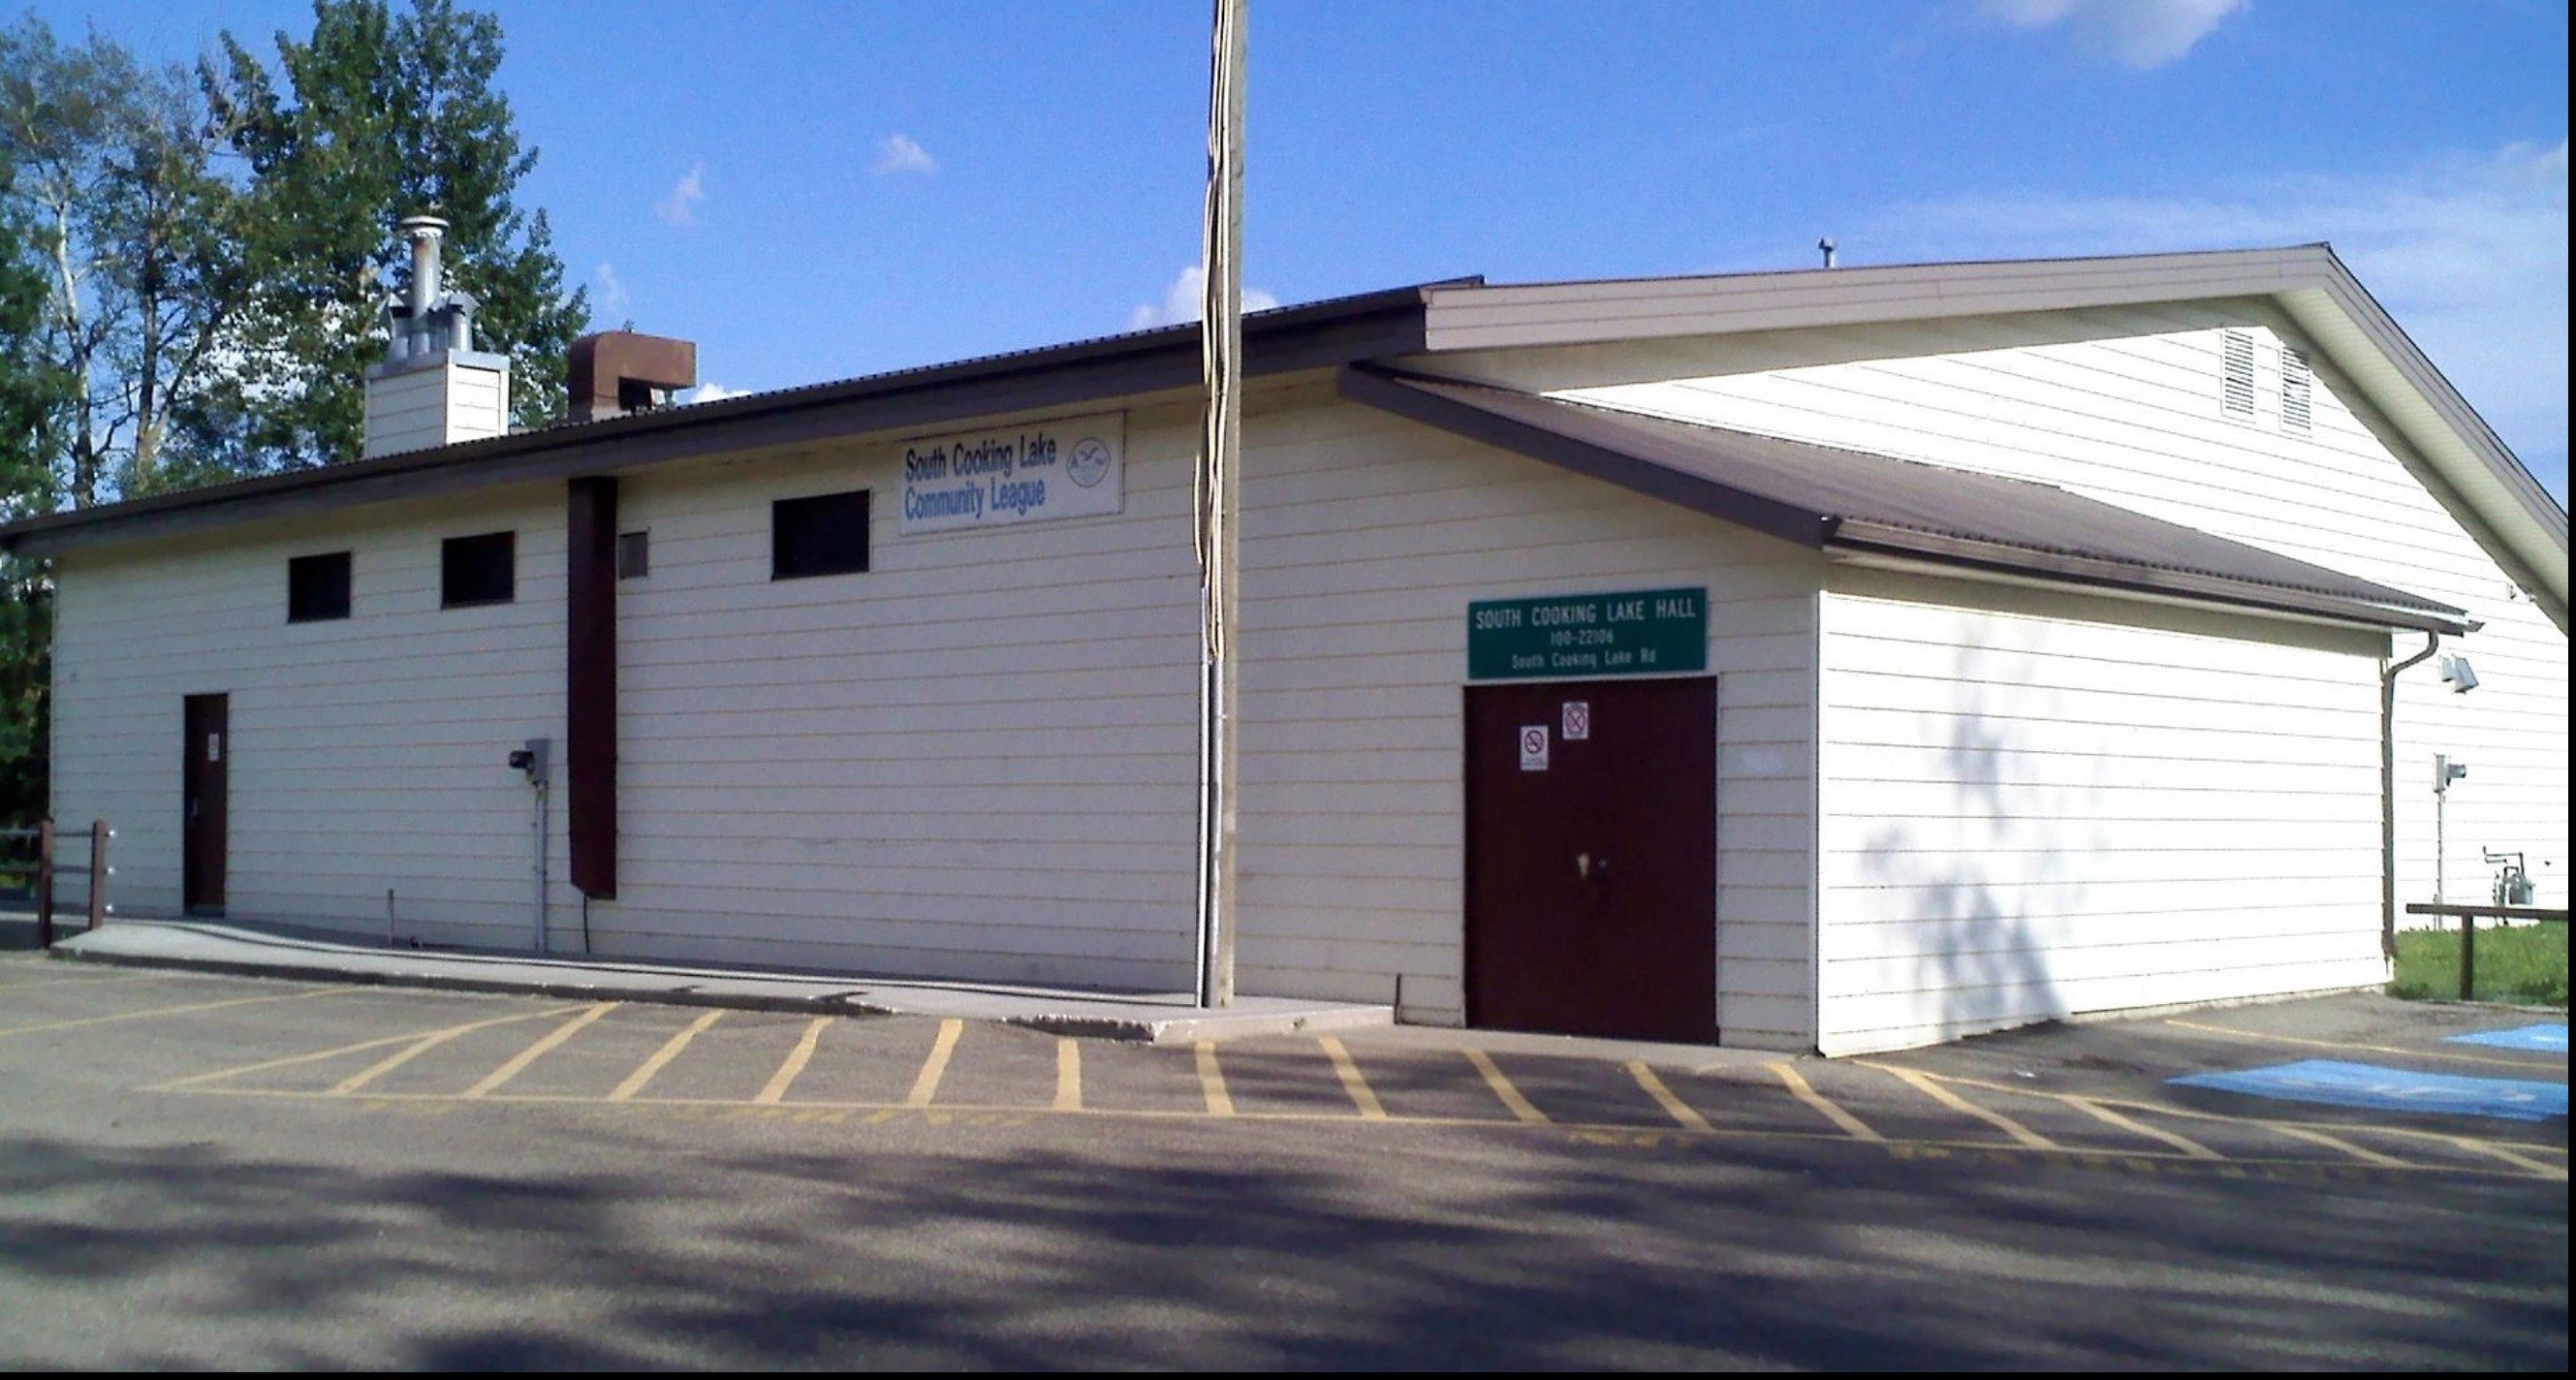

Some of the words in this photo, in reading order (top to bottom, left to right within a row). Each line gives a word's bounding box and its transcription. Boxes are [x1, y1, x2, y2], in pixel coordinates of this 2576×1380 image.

[905, 446, 947, 482] South
[953, 439, 1013, 478] Cooking
[1020, 433, 1056, 468] Lake
[905, 482, 985, 519] Community
[990, 477, 1046, 515] League
[1475, 608, 1522, 630] SOUTH
[1531, 604, 1597, 627] COOKING
[1607, 600, 1645, 623] LAKE
[1655, 597, 1697, 619] HALL
[1551, 629, 1615, 646] 100-22106
[1512, 653, 1545, 670] South
[1552, 650, 1597, 669] Cooking
[1604, 648, 1633, 666] Lake
[1640, 646, 1656, 664] Rd
